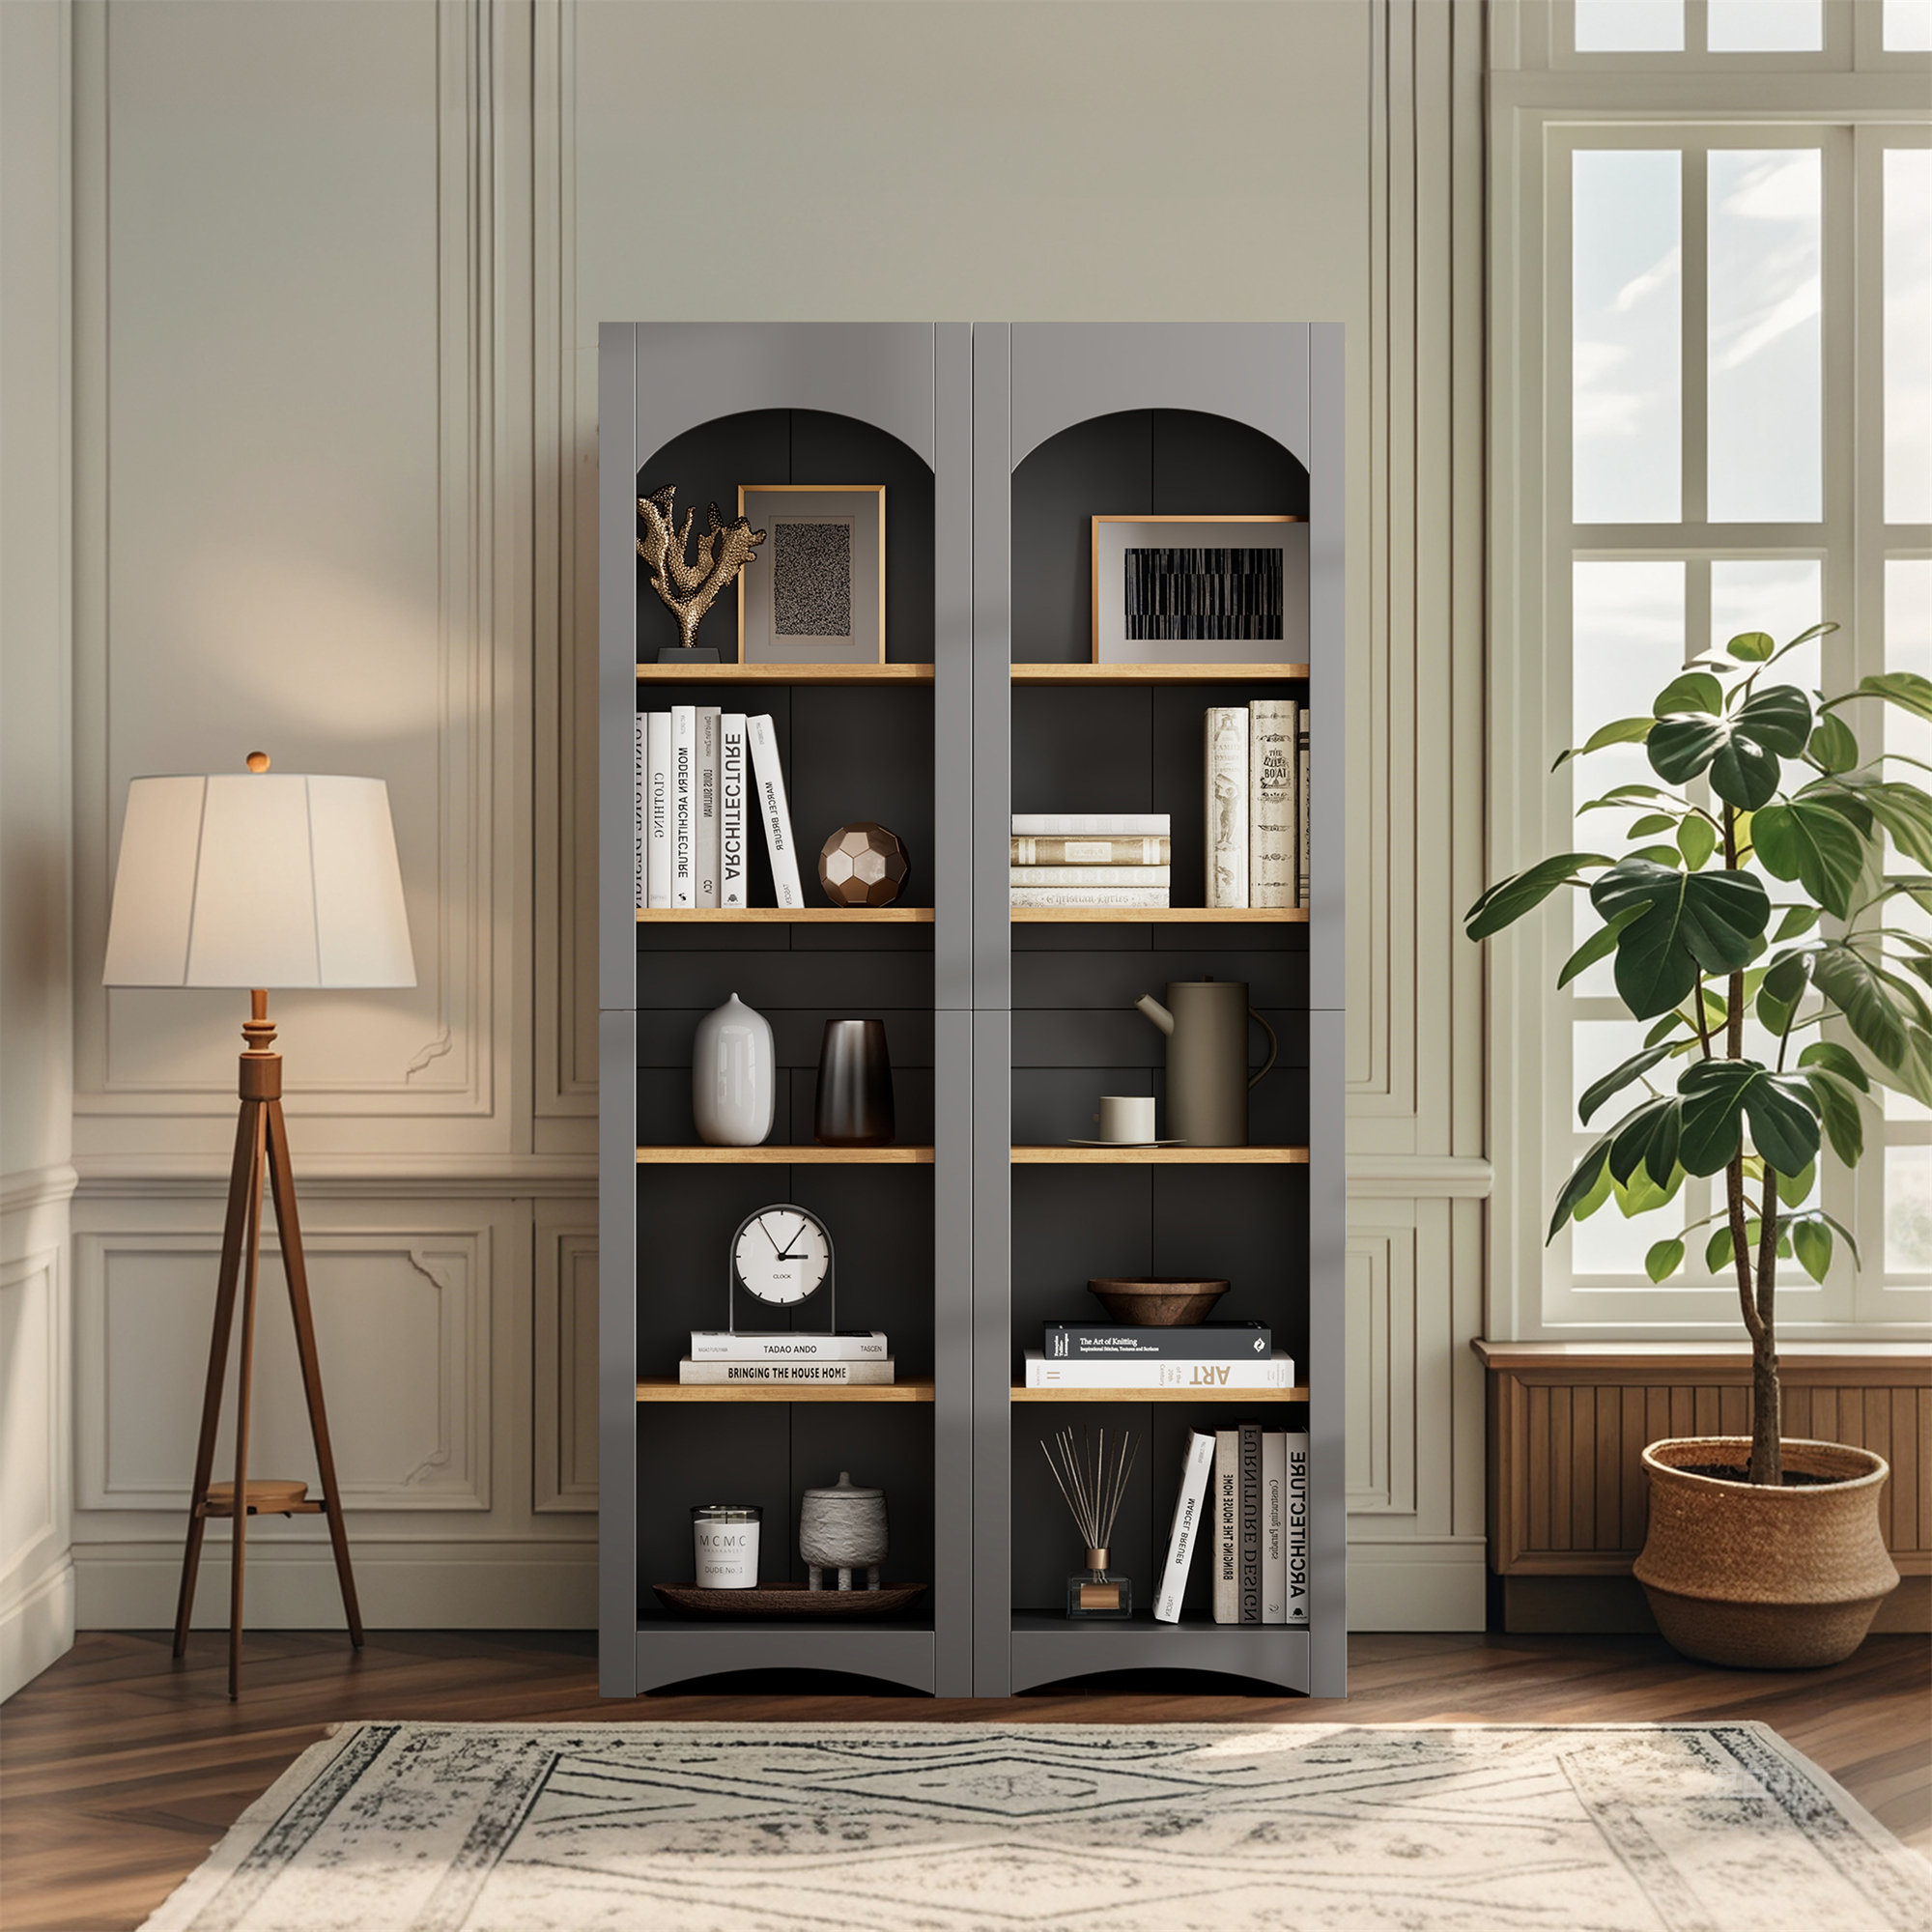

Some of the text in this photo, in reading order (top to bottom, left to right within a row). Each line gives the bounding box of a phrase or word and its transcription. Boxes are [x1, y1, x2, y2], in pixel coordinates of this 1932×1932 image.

[1264, 768, 1287, 779] BOAT
[1079, 1337, 1093, 1346] The
[1104, 1337, 1112, 1346] of
[1112, 1337, 1139, 1349] Knitting
[763, 1345, 817, 1354] TADAO ANDO
[728, 1367, 846, 1378] BRINGING THE HOUSE HOME
[1189, 1365, 1232, 1385] ART
[704, 1566, 724, 1575] DUDE
